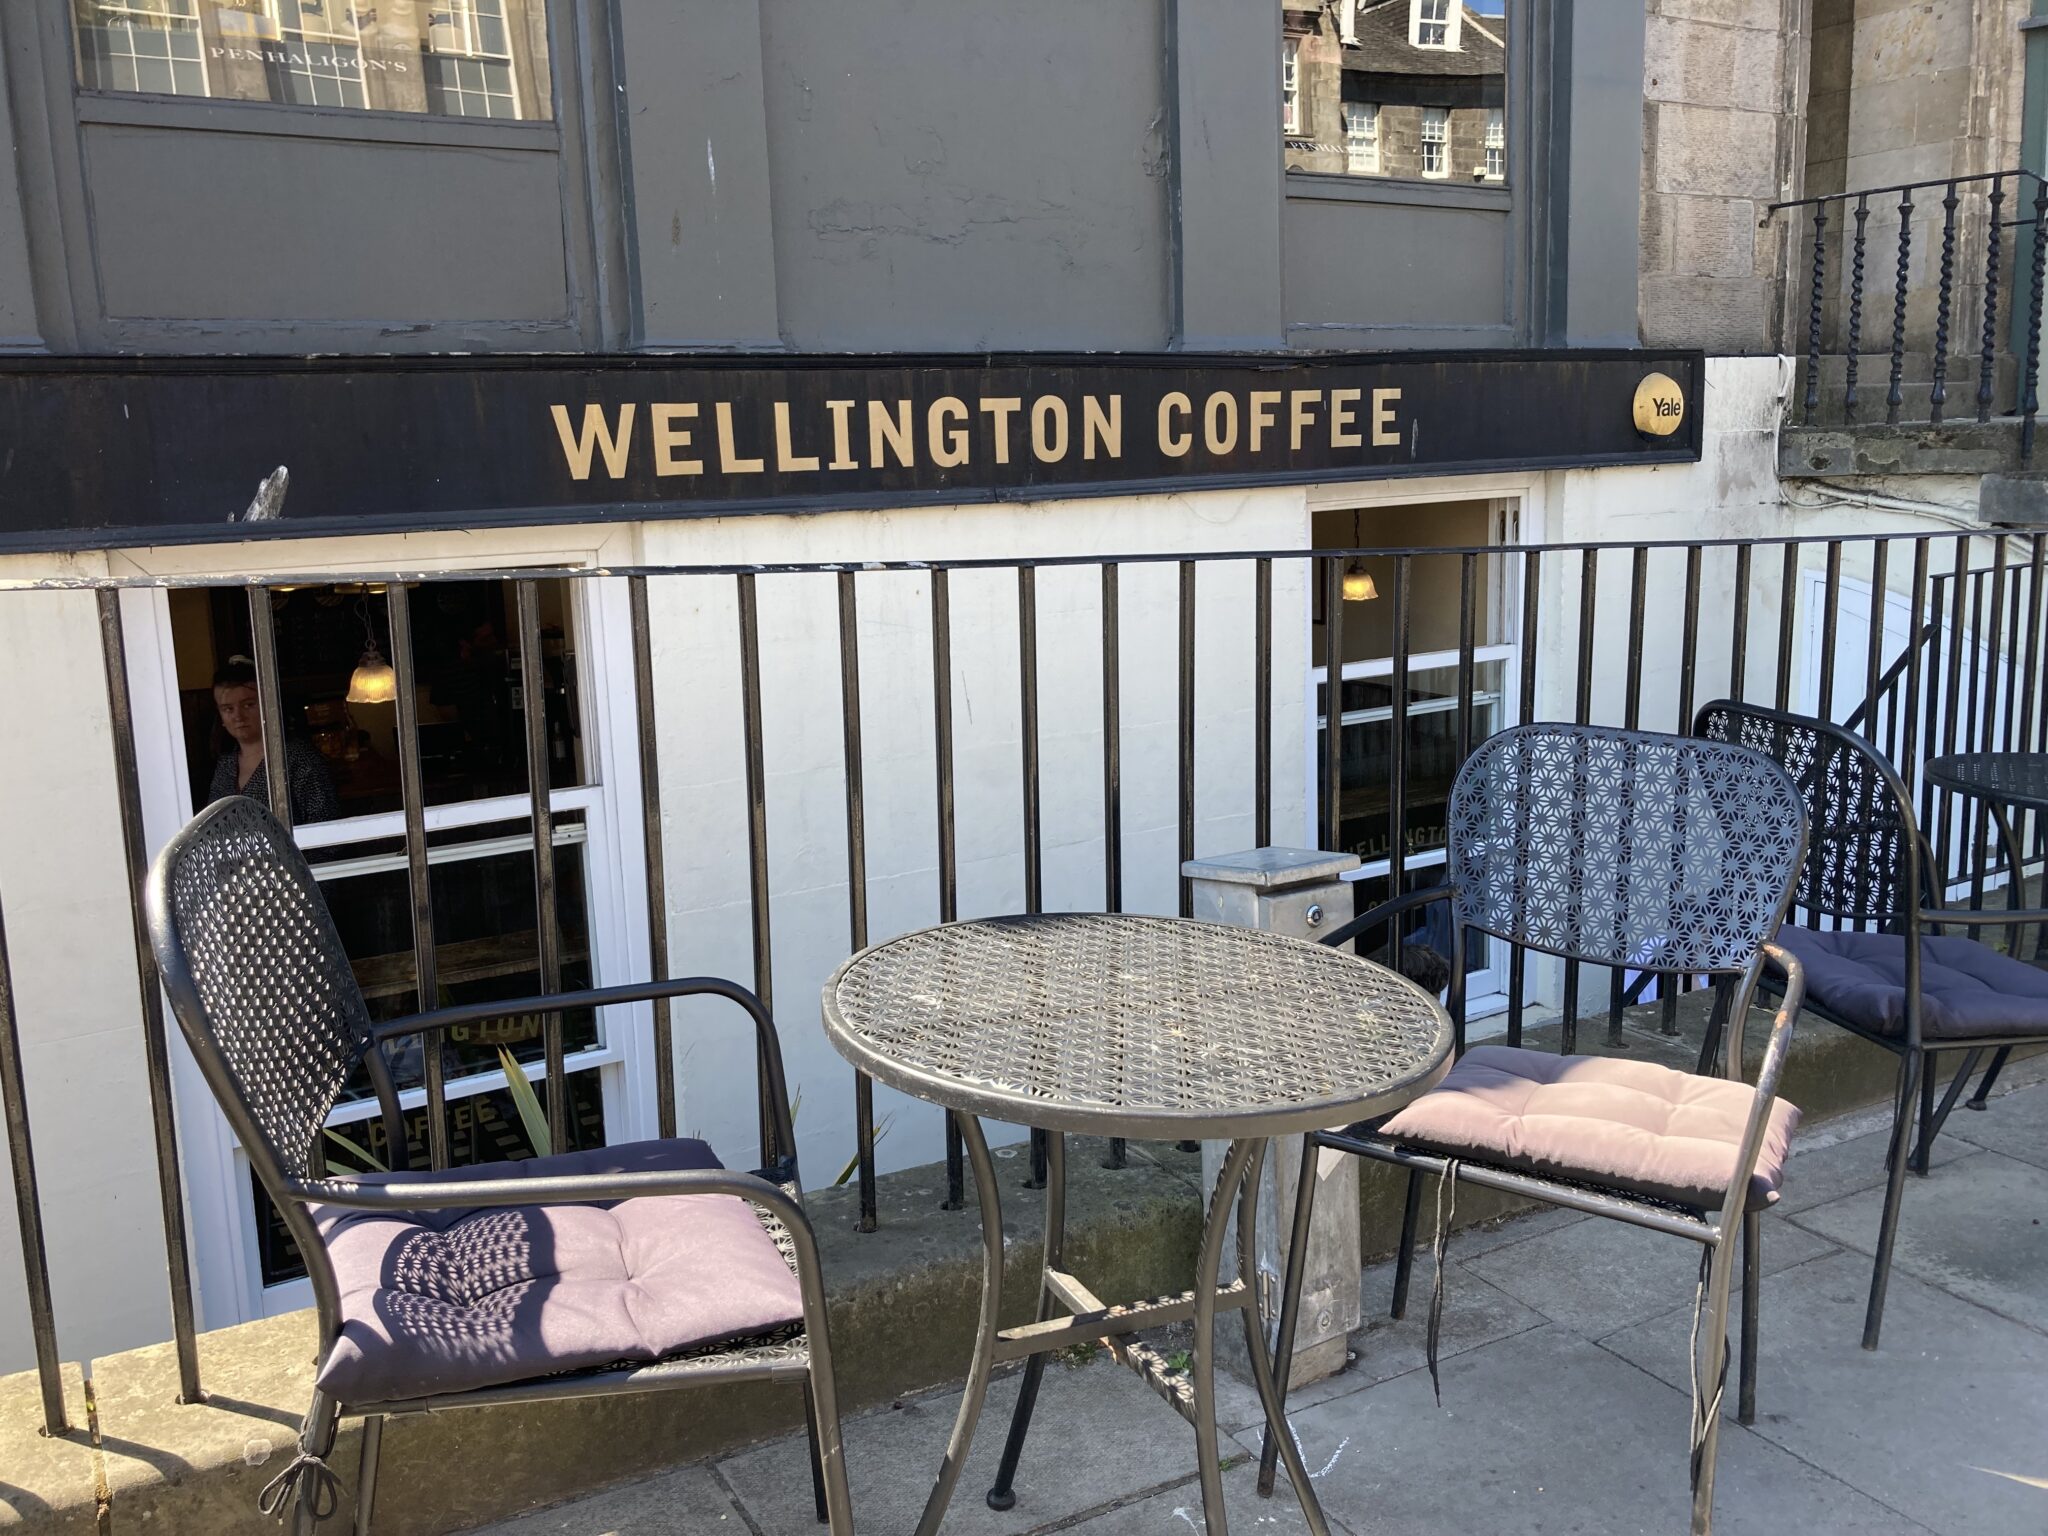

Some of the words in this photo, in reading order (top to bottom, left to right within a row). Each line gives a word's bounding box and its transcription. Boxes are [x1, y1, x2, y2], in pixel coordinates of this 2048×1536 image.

[210, 46, 408, 73] PENHALIGON'S
[1652, 397, 1681, 417] Yale
[550, 394, 1122, 480] WELLINGTON
[1158, 388, 1402, 458] COFFEE
[368, 1095, 498, 1148] CFEE
